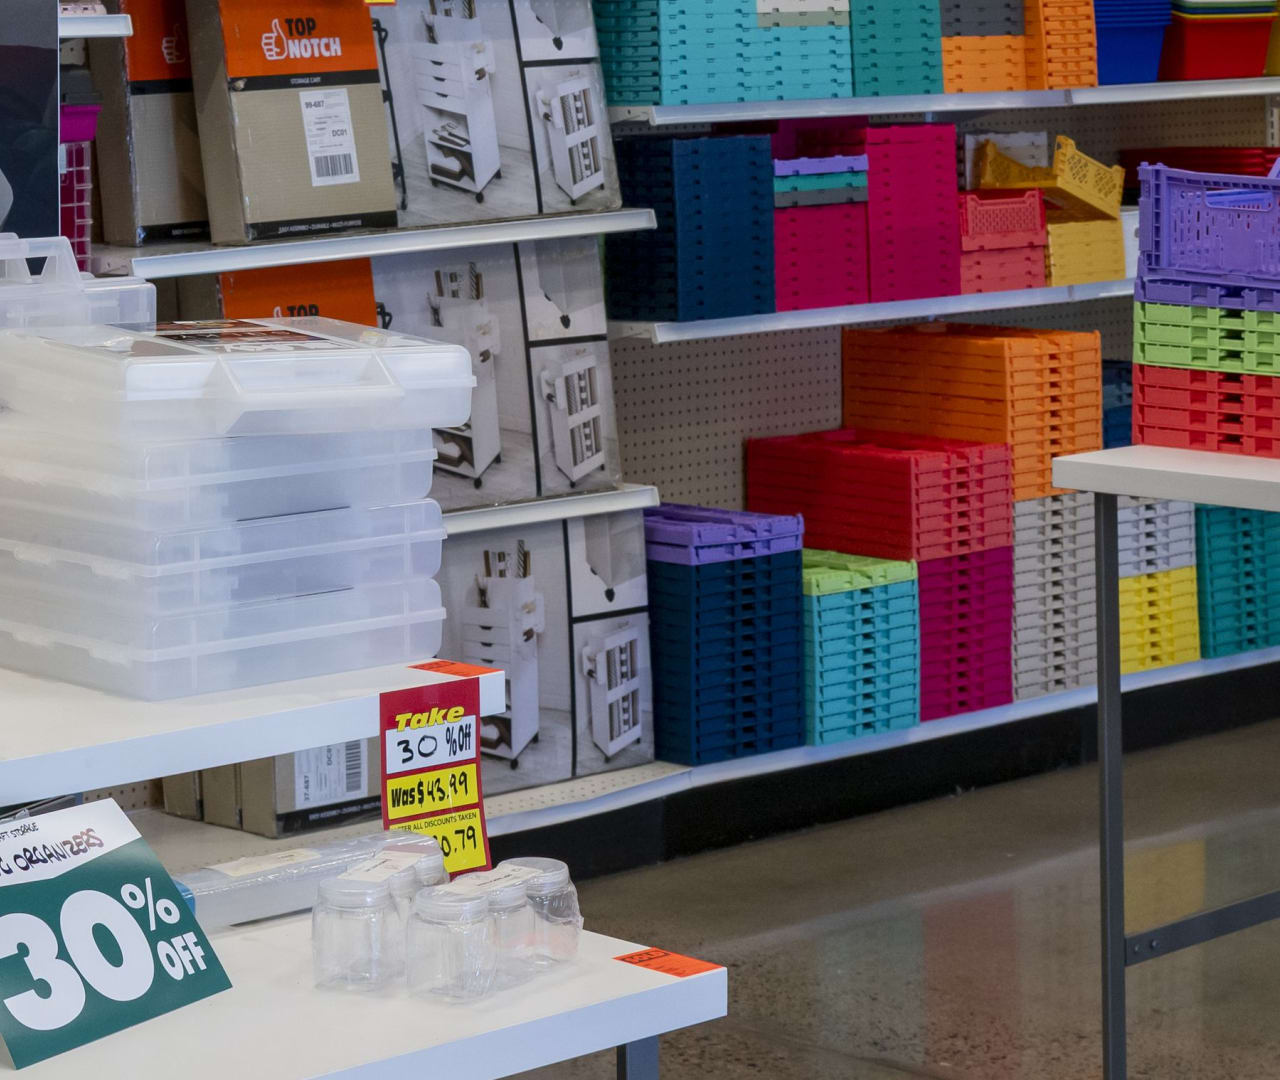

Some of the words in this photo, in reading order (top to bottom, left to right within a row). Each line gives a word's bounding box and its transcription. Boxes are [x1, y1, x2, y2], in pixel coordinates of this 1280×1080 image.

[285, 18, 316, 37] TOP
[287, 37, 342, 59] NOTCH
[395, 706, 465, 732] Take
[397, 735, 438, 764] 30
[445, 723, 472, 757] %Off
[391, 786, 416, 808] Was
[413, 822, 423, 830] ALL
[423, 815, 457, 829] DISCOUNTS
[458, 812, 477, 822] TAKEN
[13, 828, 105, 871] ORGANIZERS
[157, 931, 207, 981] OFF
